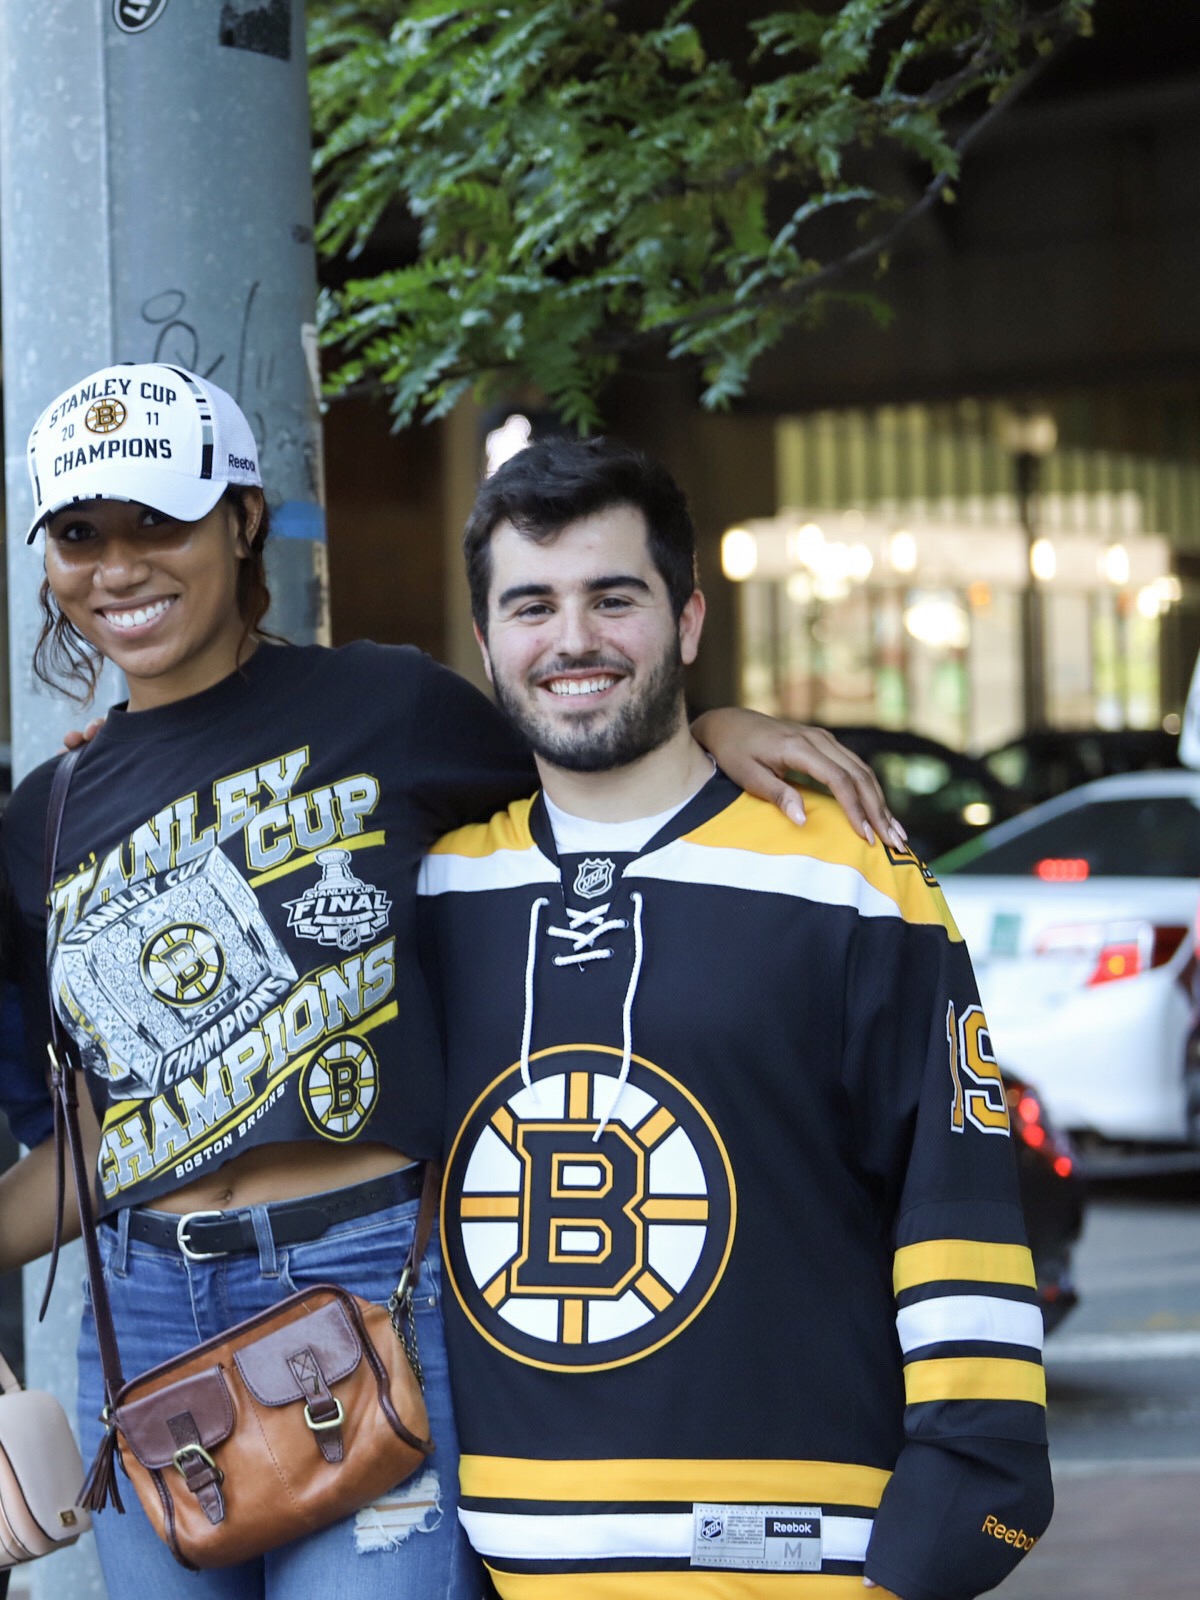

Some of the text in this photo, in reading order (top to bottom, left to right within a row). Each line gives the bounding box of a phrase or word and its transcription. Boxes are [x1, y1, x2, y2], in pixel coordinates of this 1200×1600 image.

[49, 378, 177, 429] STANLEY CUP
[61, 411, 160, 442] 20 11
[96, 406, 115, 424] B
[54, 438, 172, 477] CHAMPIONS
[228, 453, 256, 473] Reebo
[246, 773, 380, 871] CUP
[46, 745, 309, 957] TANLEY
[580, 866, 607, 890] NHL
[64, 875, 158, 942] STANLEY
[293, 893, 387, 921] FINAL
[158, 938, 208, 993] B
[163, 975, 291, 1086] CHAMPIONS
[97, 936, 396, 1199] CHAMPIONS
[327, 1054, 363, 1119] B
[174, 1086, 286, 1180] BOSTON BRUINS
[511, 1121, 645, 1300] B
[773, 1521, 813, 1534] Reebok
[784, 1541, 803, 1559] M
[981, 1514, 1038, 1551] Reebo
